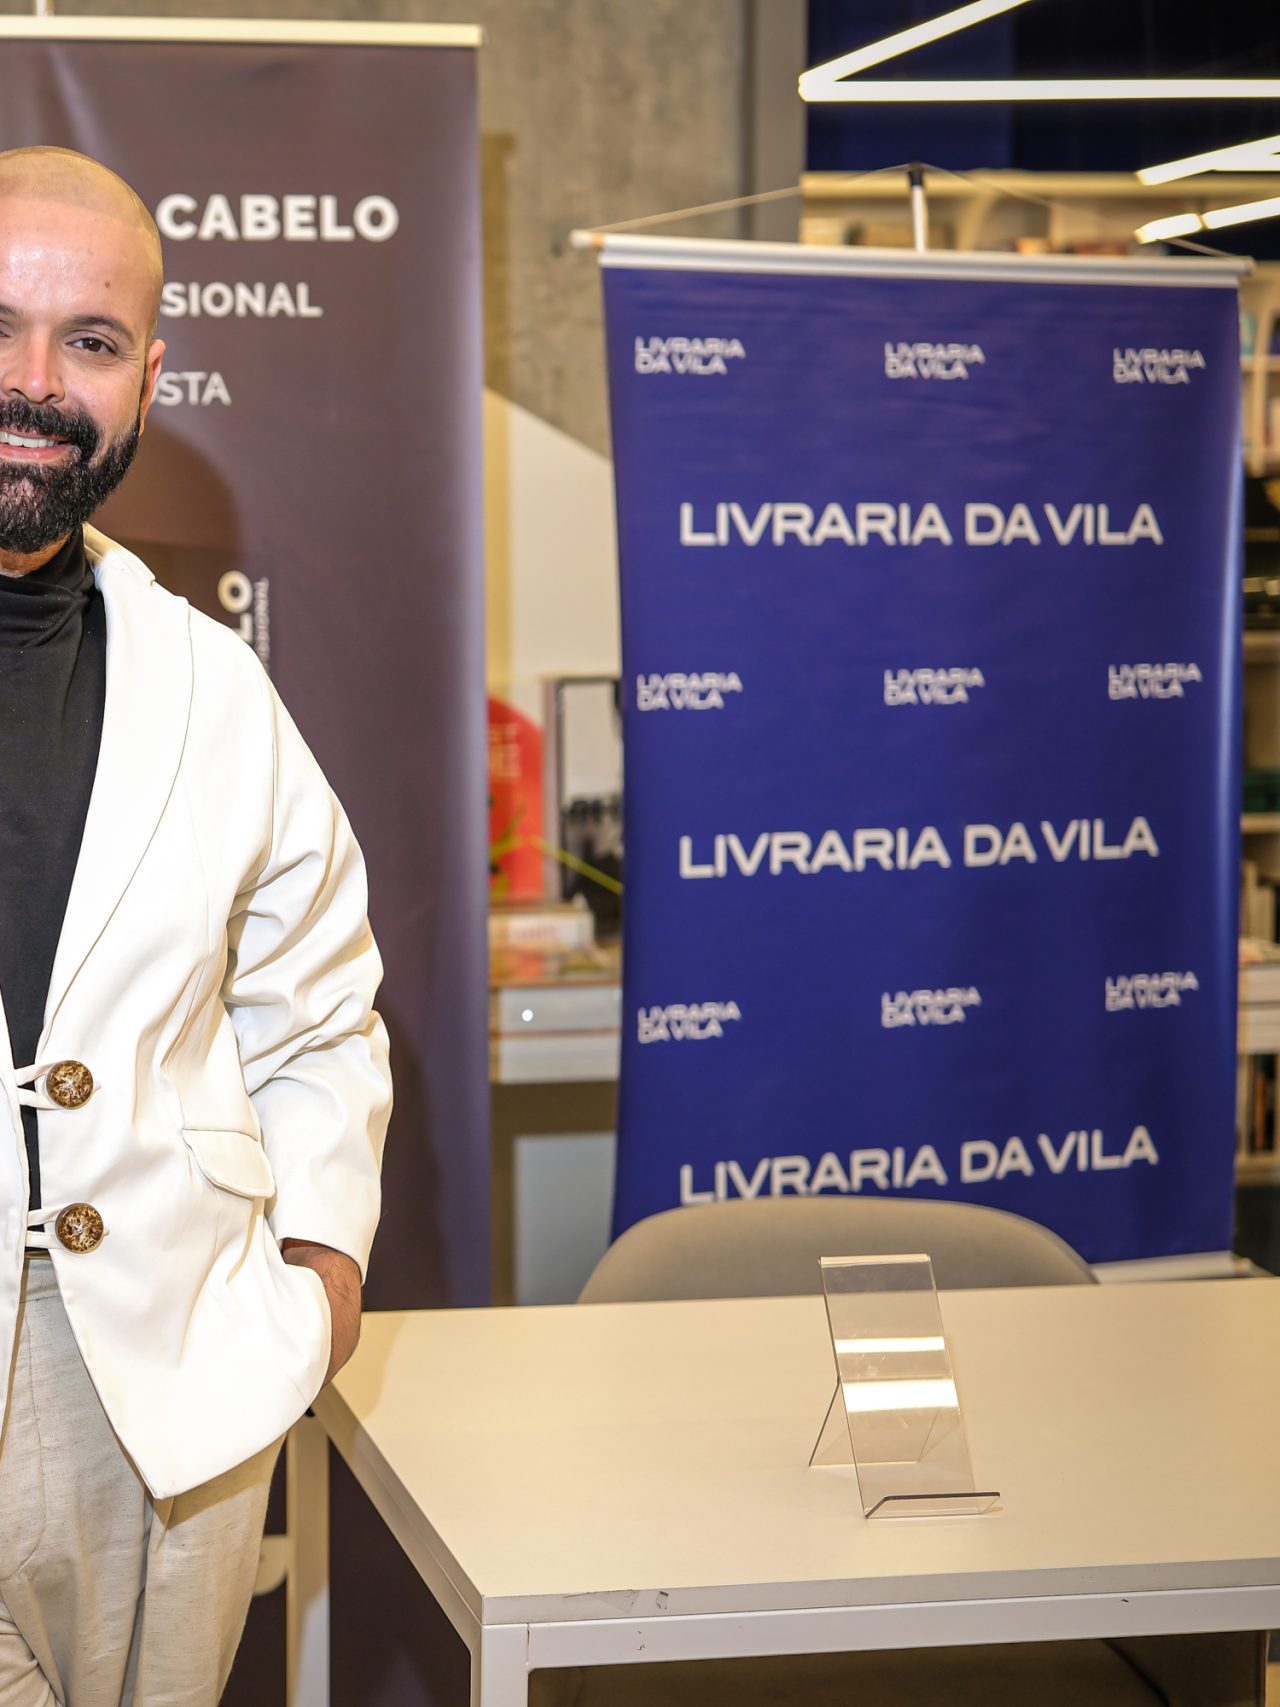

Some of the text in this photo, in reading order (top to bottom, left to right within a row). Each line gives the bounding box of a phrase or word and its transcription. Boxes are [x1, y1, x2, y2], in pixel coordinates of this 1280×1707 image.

[155, 193, 399, 242] CABELO
[634, 336, 746, 359] LIVRARIA
[884, 342, 985, 364] LIVRARIA
[1113, 347, 1206, 369] LIVRARIA
[151, 371, 232, 406] STA
[679, 502, 1164, 546] LIVRARIA DA VILA
[636, 672, 743, 694] LIVRARIA
[883, 667, 985, 688] LIVRARIA
[1108, 662, 1203, 683] LIVRARIA
[679, 816, 1159, 880] LIVRARIA DA VILA
[1105, 971, 1199, 992] LIVRARIA
[881, 986, 982, 1008] LIVRARIA
[637, 1000, 741, 1022] LIVRARIA
[679, 1125, 1159, 1205] LIVRARIA DA VILA
